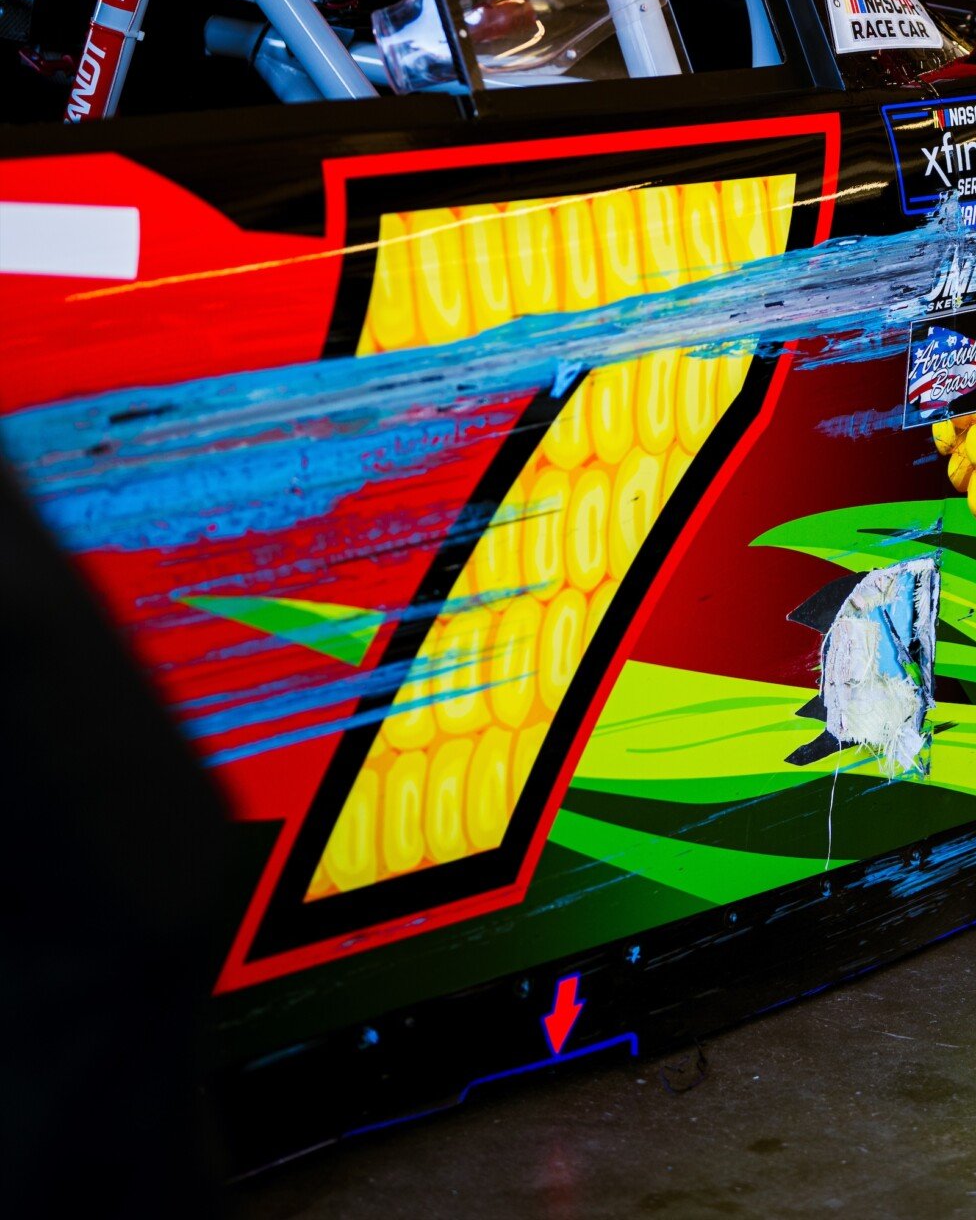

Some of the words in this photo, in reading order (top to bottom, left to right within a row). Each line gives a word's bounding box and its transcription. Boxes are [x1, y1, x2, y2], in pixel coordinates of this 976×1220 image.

[851, 20, 896, 40] RACE
[898, 20, 930, 38] CAR
[64, 33, 107, 124] ANDT
[931, 368, 976, 399] Brass
